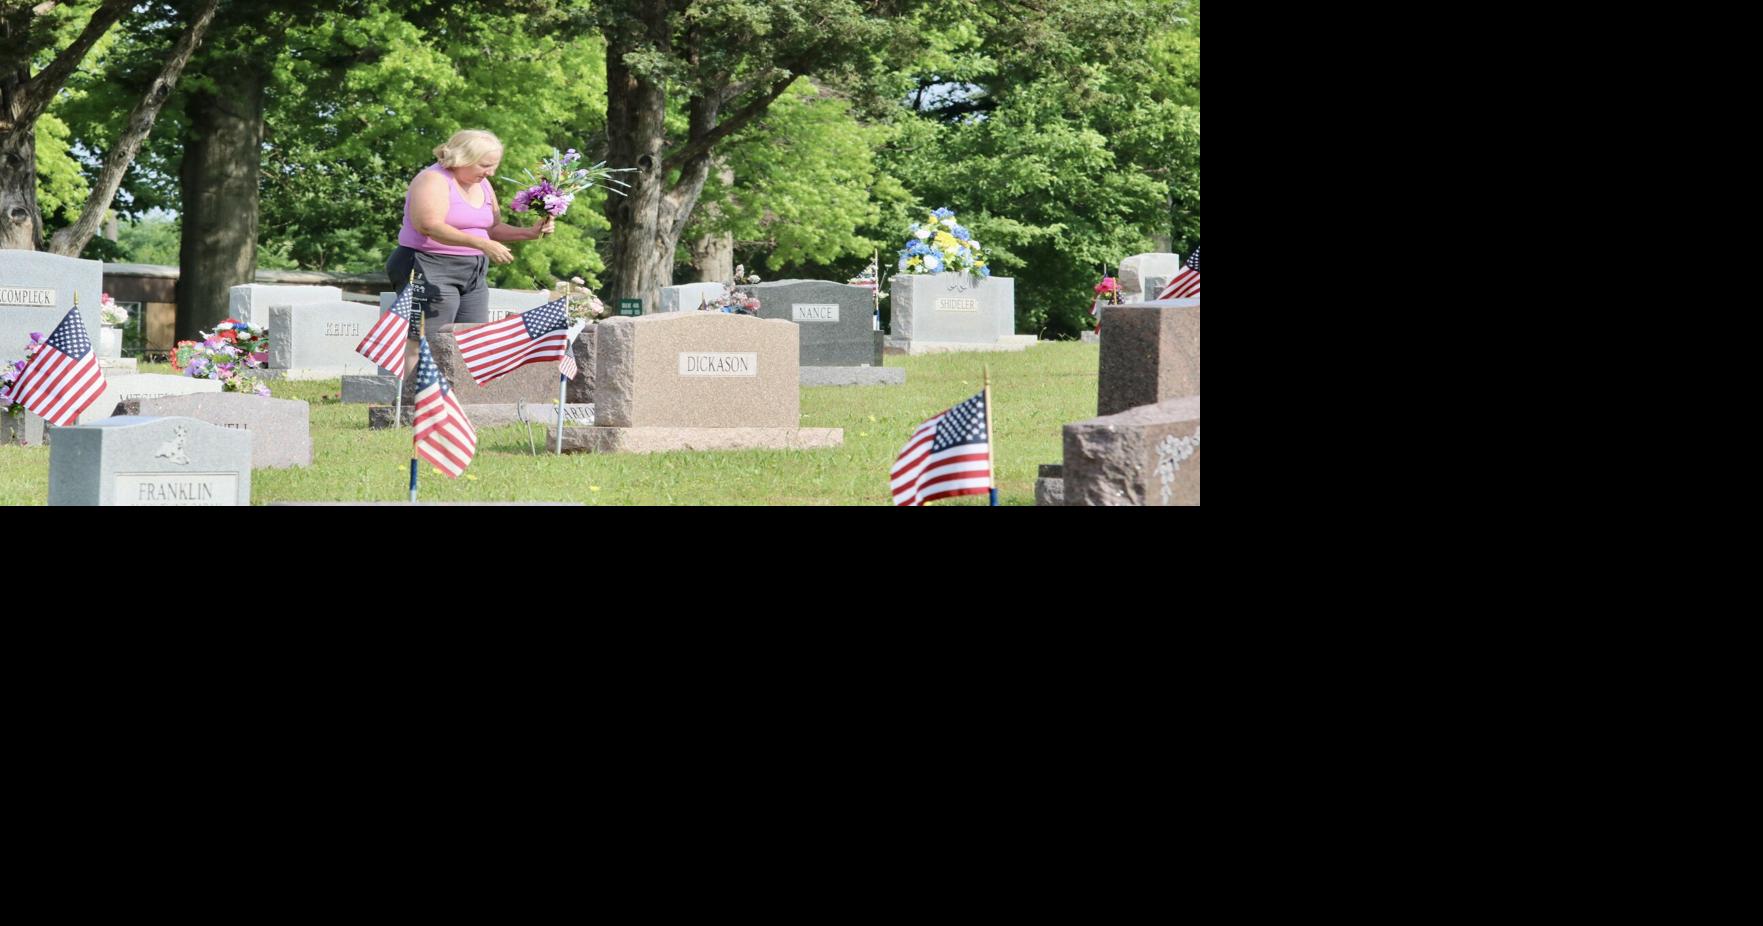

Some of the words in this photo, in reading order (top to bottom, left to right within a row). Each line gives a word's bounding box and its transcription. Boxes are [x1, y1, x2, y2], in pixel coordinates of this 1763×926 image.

[0, 289, 51, 304] COMPLECK
[799, 306, 833, 319] NANCE
[324, 321, 360, 336] KEITH
[687, 356, 748, 372] DICKASON
[553, 406, 594, 419] ARTO
[138, 482, 213, 500] FRANKLIN
